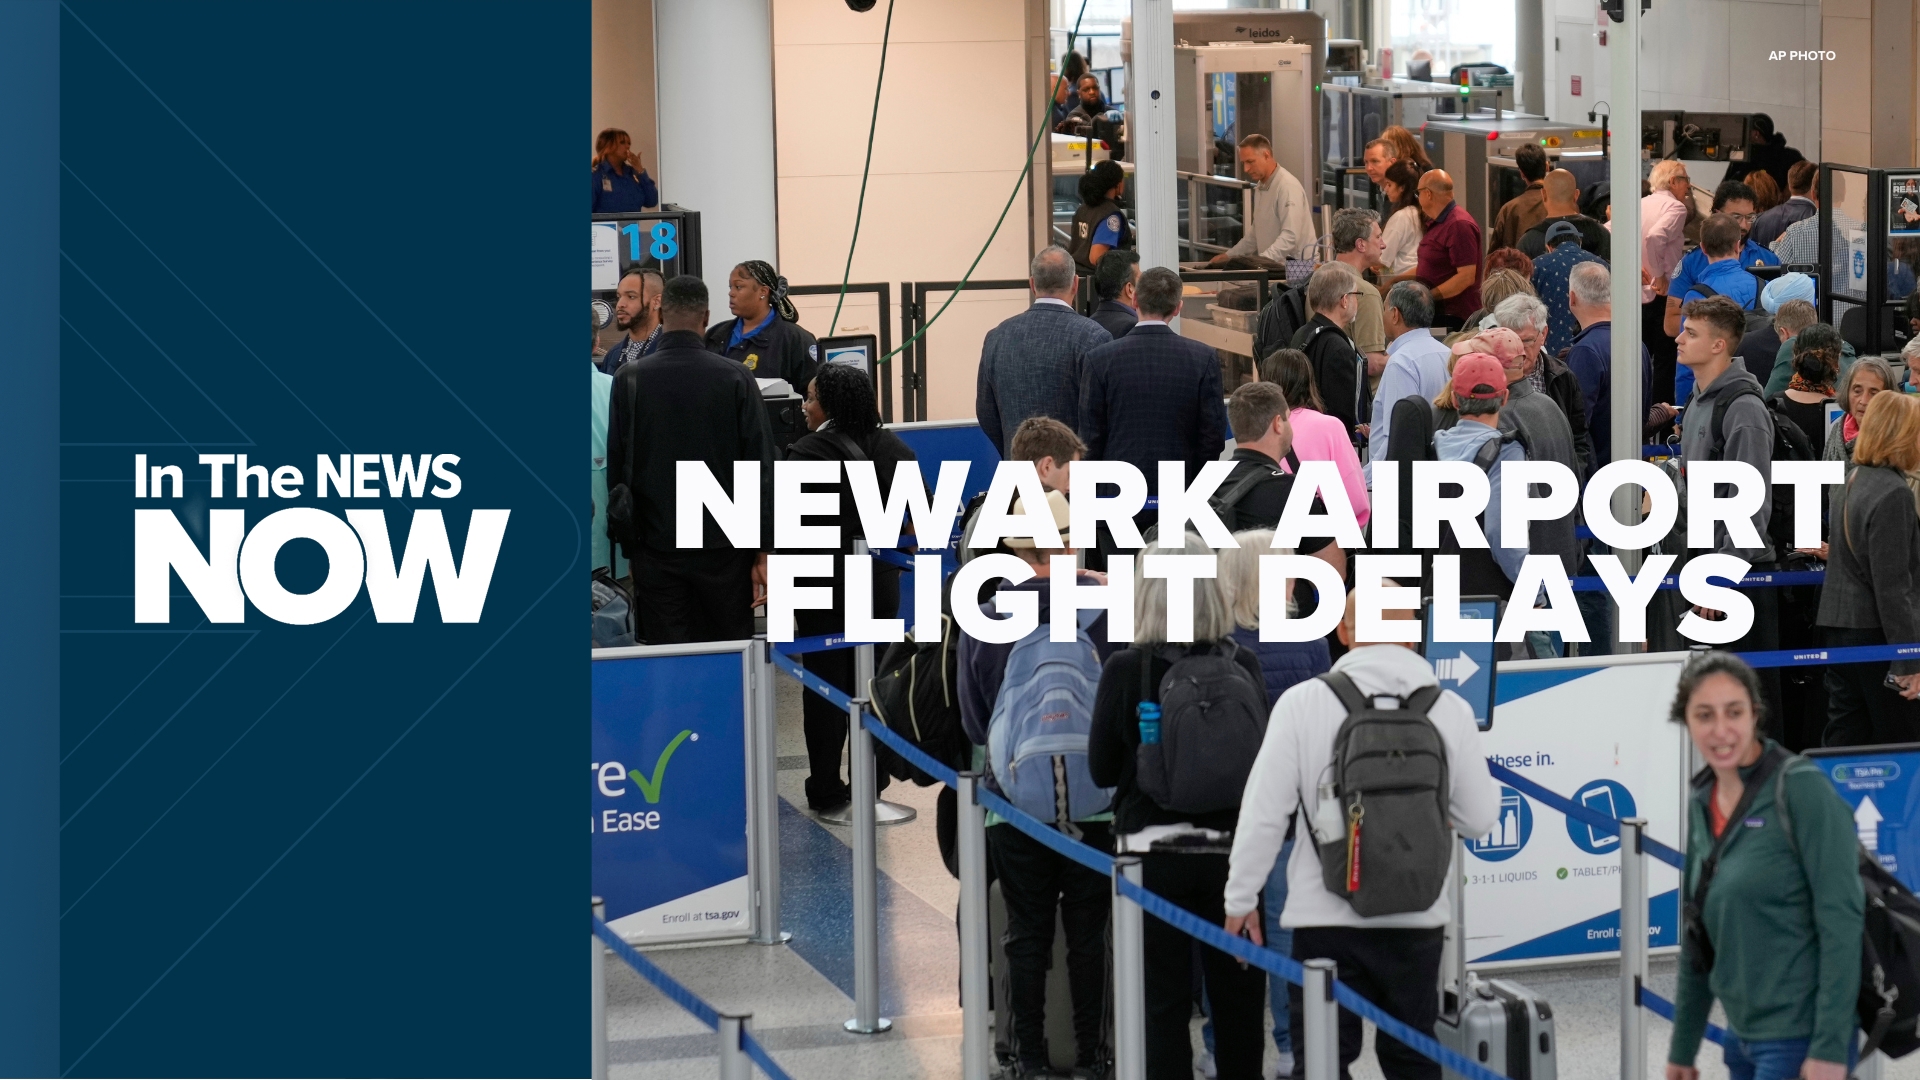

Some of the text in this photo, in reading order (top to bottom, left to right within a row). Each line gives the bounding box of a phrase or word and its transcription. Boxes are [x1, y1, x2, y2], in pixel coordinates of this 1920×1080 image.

[1249, 28, 1280, 38] leidos
[621, 222, 678, 261] 18
[1536, 751, 1555, 766] in.
[602, 809, 661, 833] Ease
[1472, 871, 1538, 885] 3-1-1 LIQUIDS
[662, 909, 740, 924] Enroll at tsa.gov
[1587, 927, 1614, 940] Enroll
